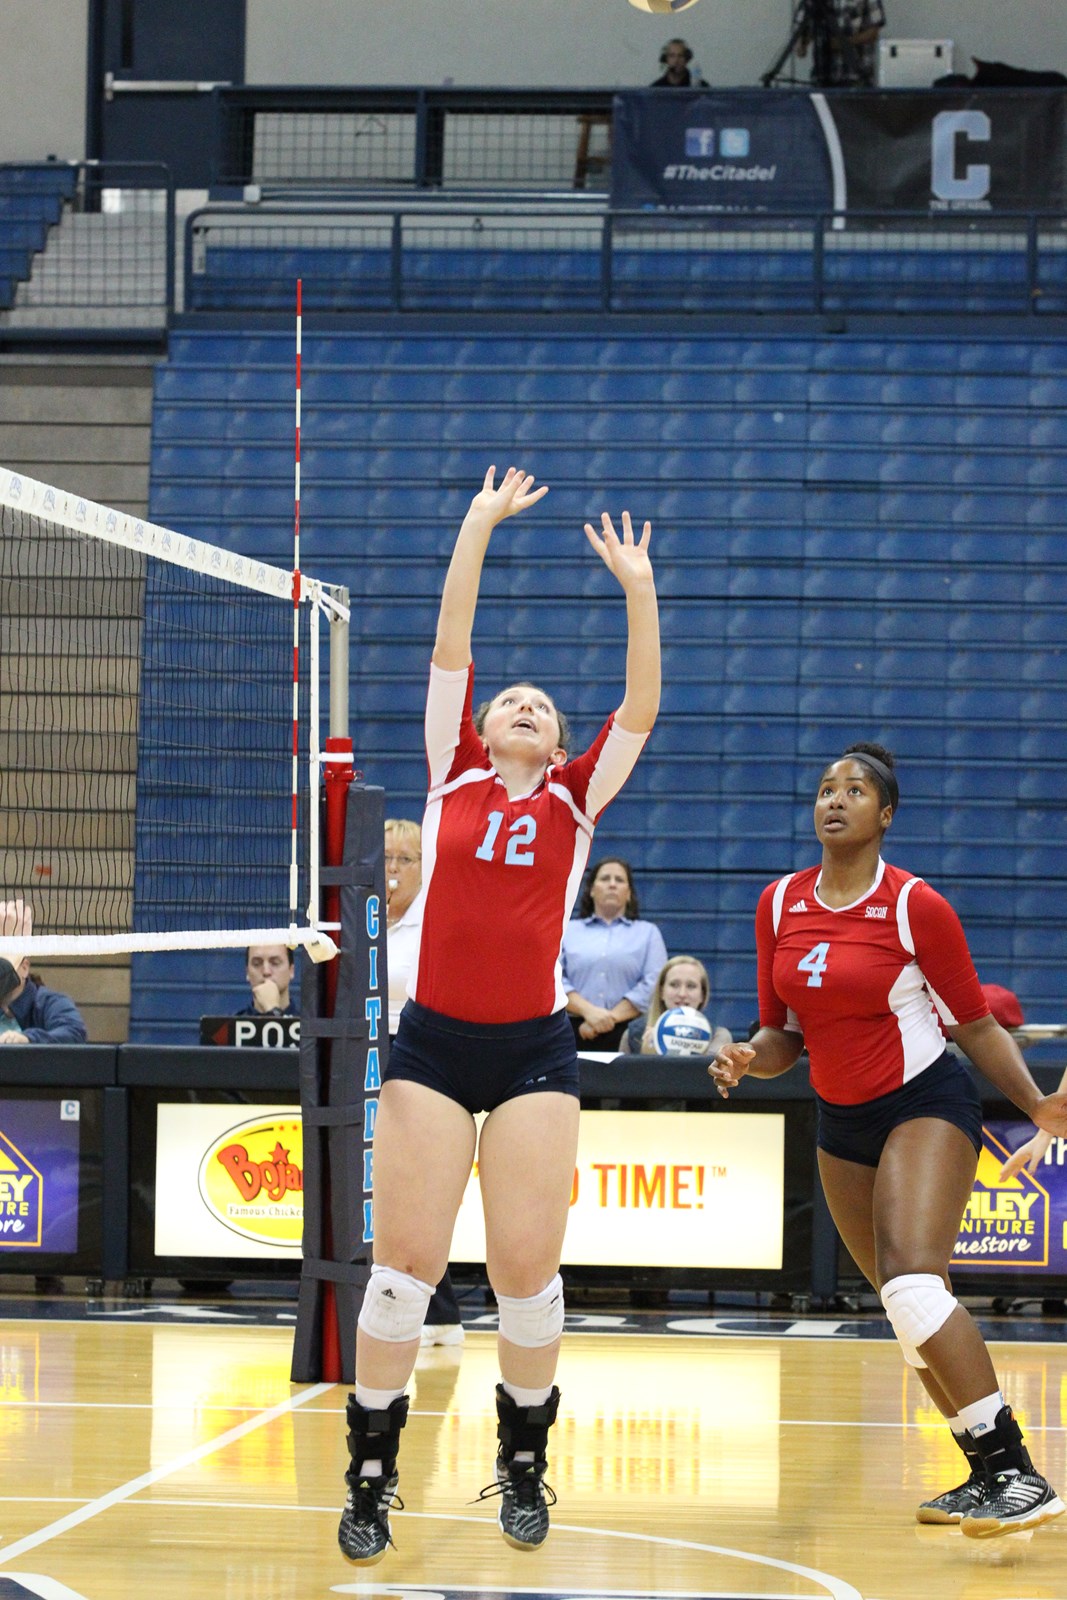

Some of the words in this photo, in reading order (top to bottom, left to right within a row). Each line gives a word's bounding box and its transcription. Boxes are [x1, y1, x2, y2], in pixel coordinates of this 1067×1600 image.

[663, 164, 777, 180] #TheCitadel
[931, 110, 991, 200] C
[475, 811, 537, 867] 12
[797, 942, 830, 987] 4
[217, 1144, 303, 1202] Boja
[590, 1164, 705, 1209] TIME!
[229, 1206, 265, 1215] Famous
[268, 1207, 303, 1217] Chicke
